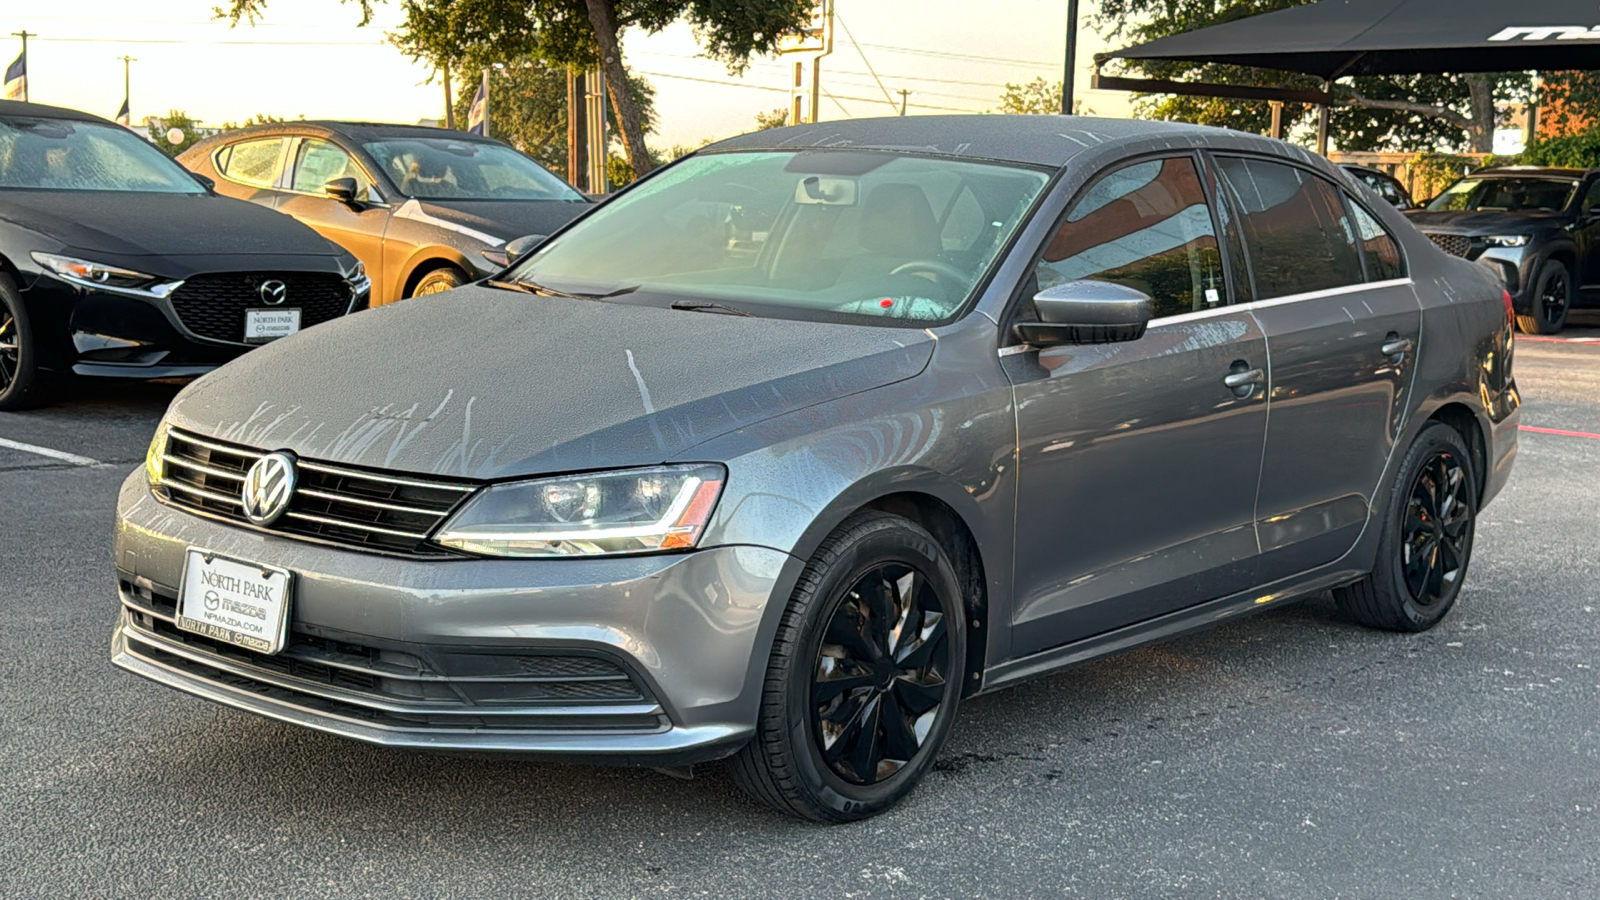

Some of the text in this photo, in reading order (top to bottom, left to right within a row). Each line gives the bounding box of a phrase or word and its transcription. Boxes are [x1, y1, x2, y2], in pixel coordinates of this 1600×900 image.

[253, 316, 276, 324] NORTH
[201, 569, 274, 602] NORTH PARK
[181, 617, 207, 634] NORTH
[208, 625, 232, 641] PARK
[204, 611, 263, 634] NPMAZDA.COM
